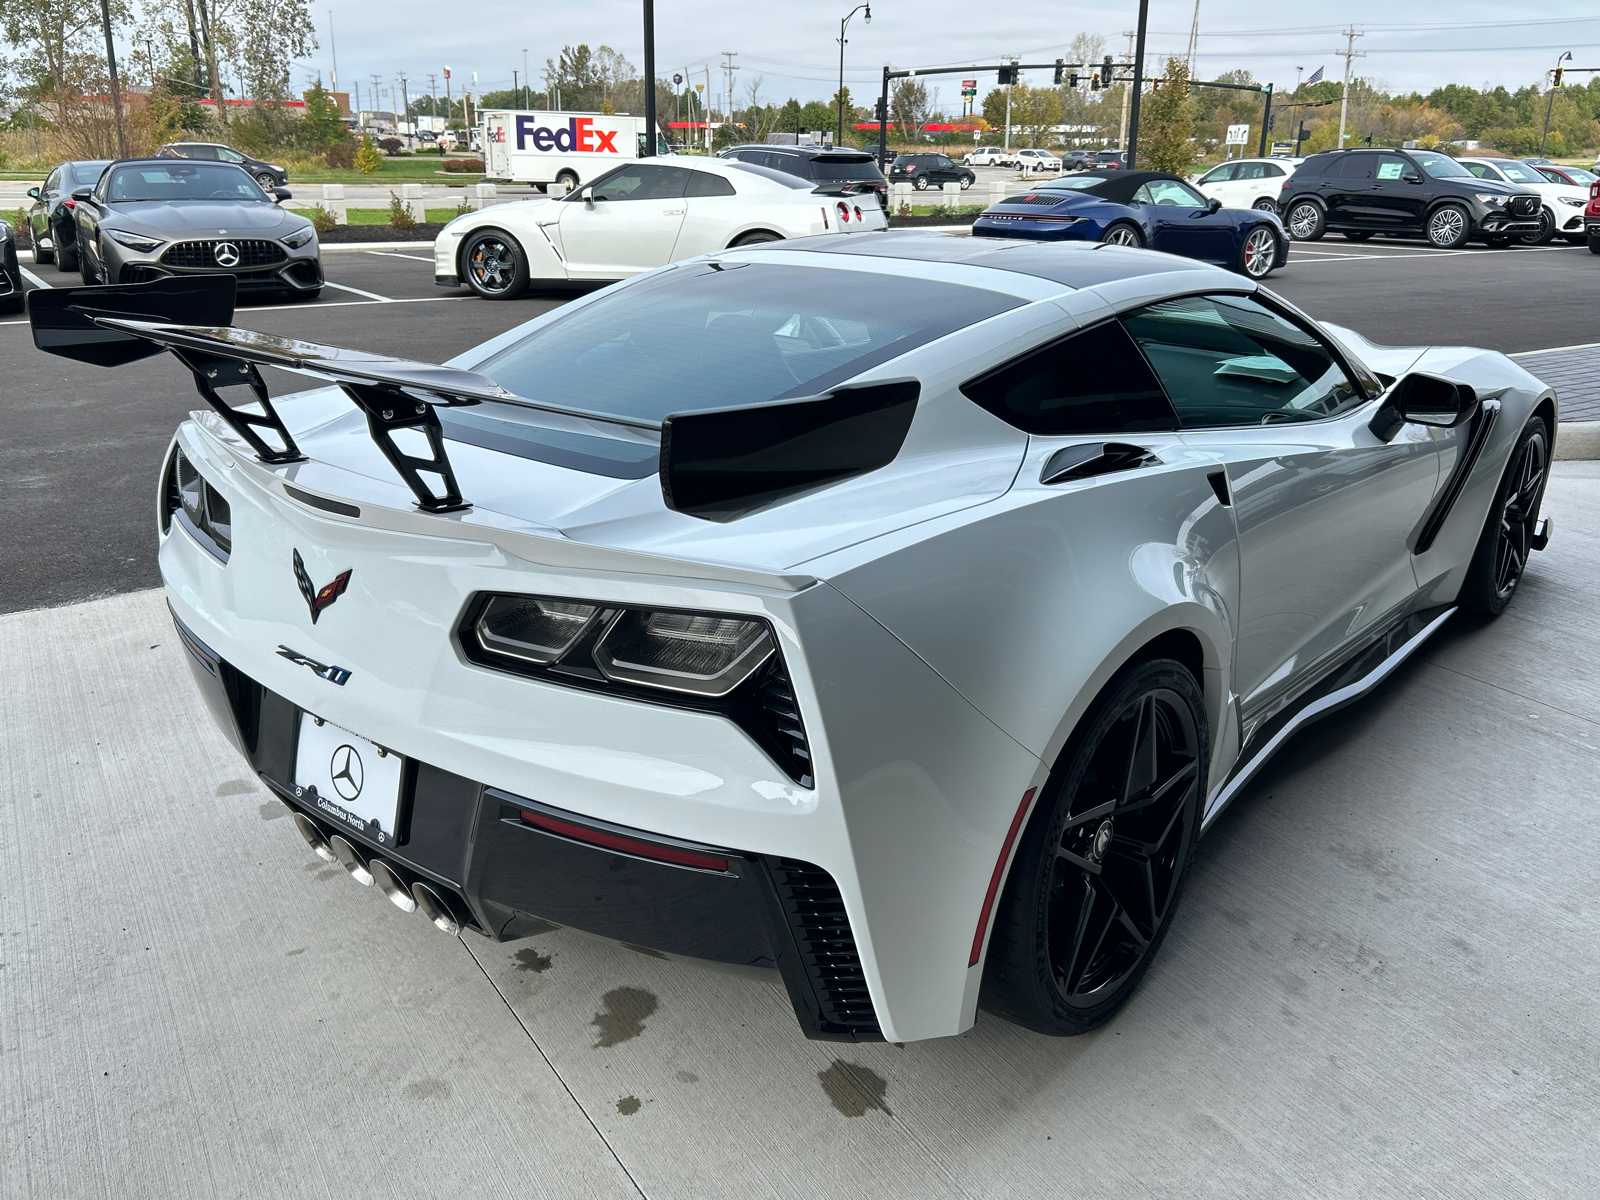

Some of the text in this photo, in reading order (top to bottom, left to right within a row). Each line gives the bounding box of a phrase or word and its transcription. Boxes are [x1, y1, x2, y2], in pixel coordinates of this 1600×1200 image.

[487, 126, 506, 143] FedEx
[516, 115, 618, 153] FedEx
[276, 644, 352, 686] ZR1
[317, 797, 365, 831] Columbus North
[1036, 854, 1052, 933] MICHELIN
